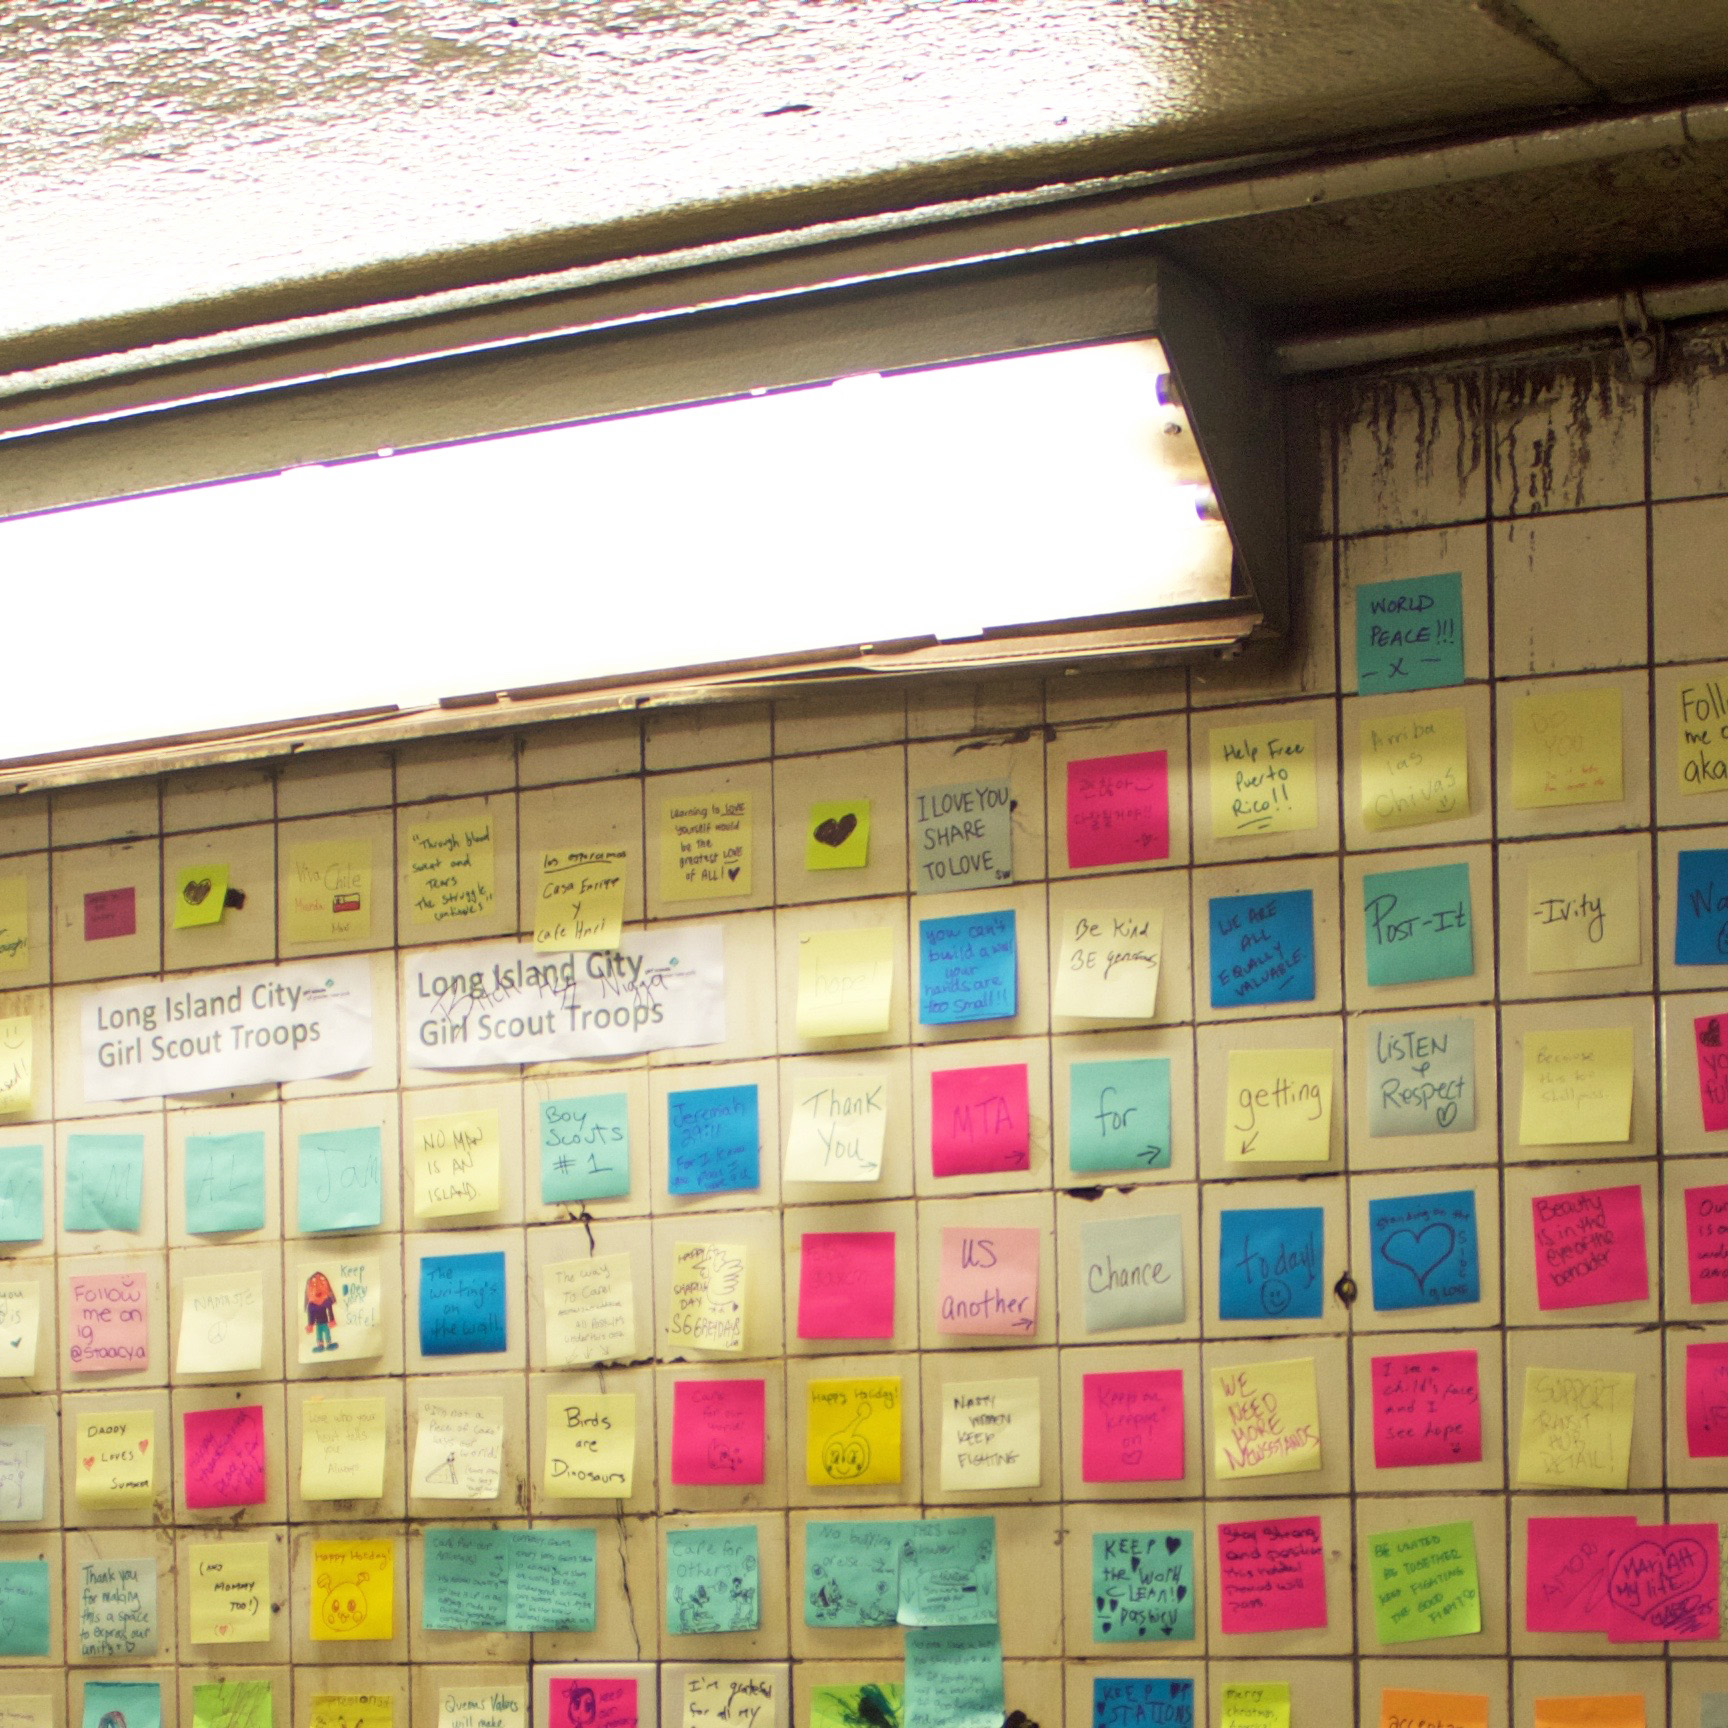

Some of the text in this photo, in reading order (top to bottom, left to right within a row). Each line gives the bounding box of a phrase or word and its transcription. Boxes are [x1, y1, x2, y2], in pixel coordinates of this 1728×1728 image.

[1370, 595, 1434, 615] WORLD
[1223, 740, 1259, 762] Help
[1685, 728, 1712, 746] me
[931, 793, 973, 815] LOVE
[977, 788, 1009, 810] YOU
[924, 821, 986, 850] SHARE
[416, 949, 644, 1002] Long Island City
[97, 981, 304, 1033] Long Island City
[417, 1001, 663, 1048] Girl Scout Troops
[97, 1016, 322, 1070] Girl Scout Troops
[801, 1084, 883, 1118] Thank
[1232, 1078, 1323, 1131] getting
[1380, 1074, 1465, 1110] Respect
[952, 1104, 1015, 1137] MTA
[1094, 1086, 1139, 1137] for
[941, 1291, 1031, 1321] another
